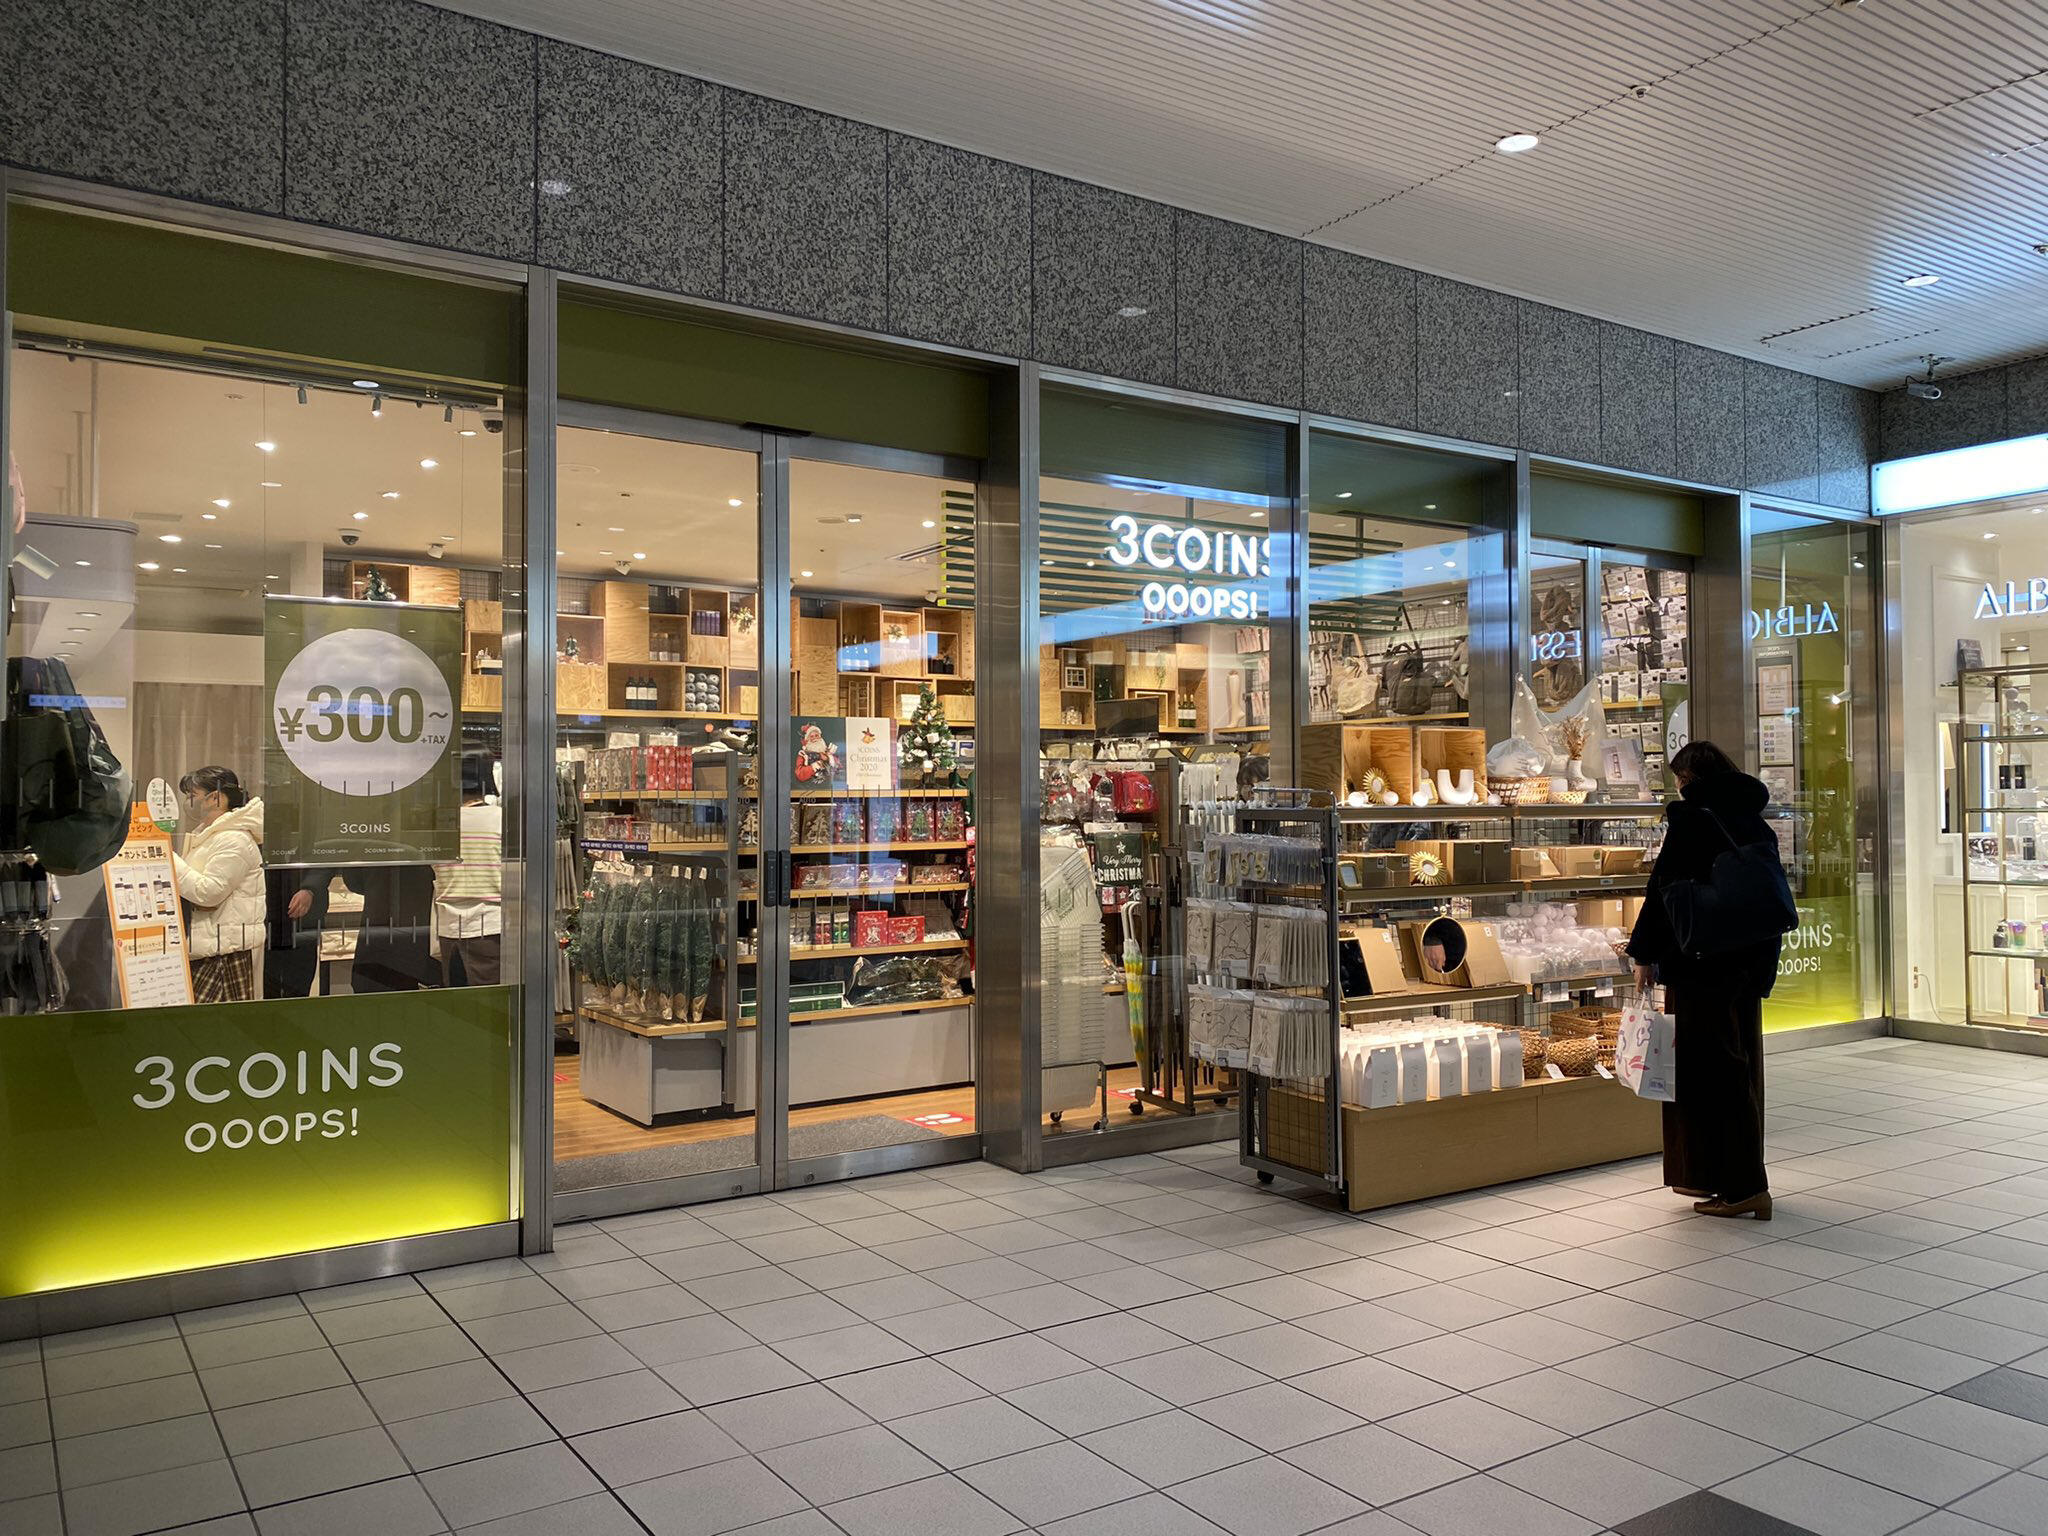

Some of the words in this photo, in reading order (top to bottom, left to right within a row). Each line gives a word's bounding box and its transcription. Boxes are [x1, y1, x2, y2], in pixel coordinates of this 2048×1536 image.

[1142, 582, 1258, 620] OOOPS!
[420, 735, 446, 744] +TAX
[339, 822, 391, 834] 3COINS
[1102, 855, 1120, 867] Very
[1781, 923, 1832, 951] OINS
[133, 1042, 404, 1109] 3COINS
[184, 1107, 358, 1153] OOOPS!
